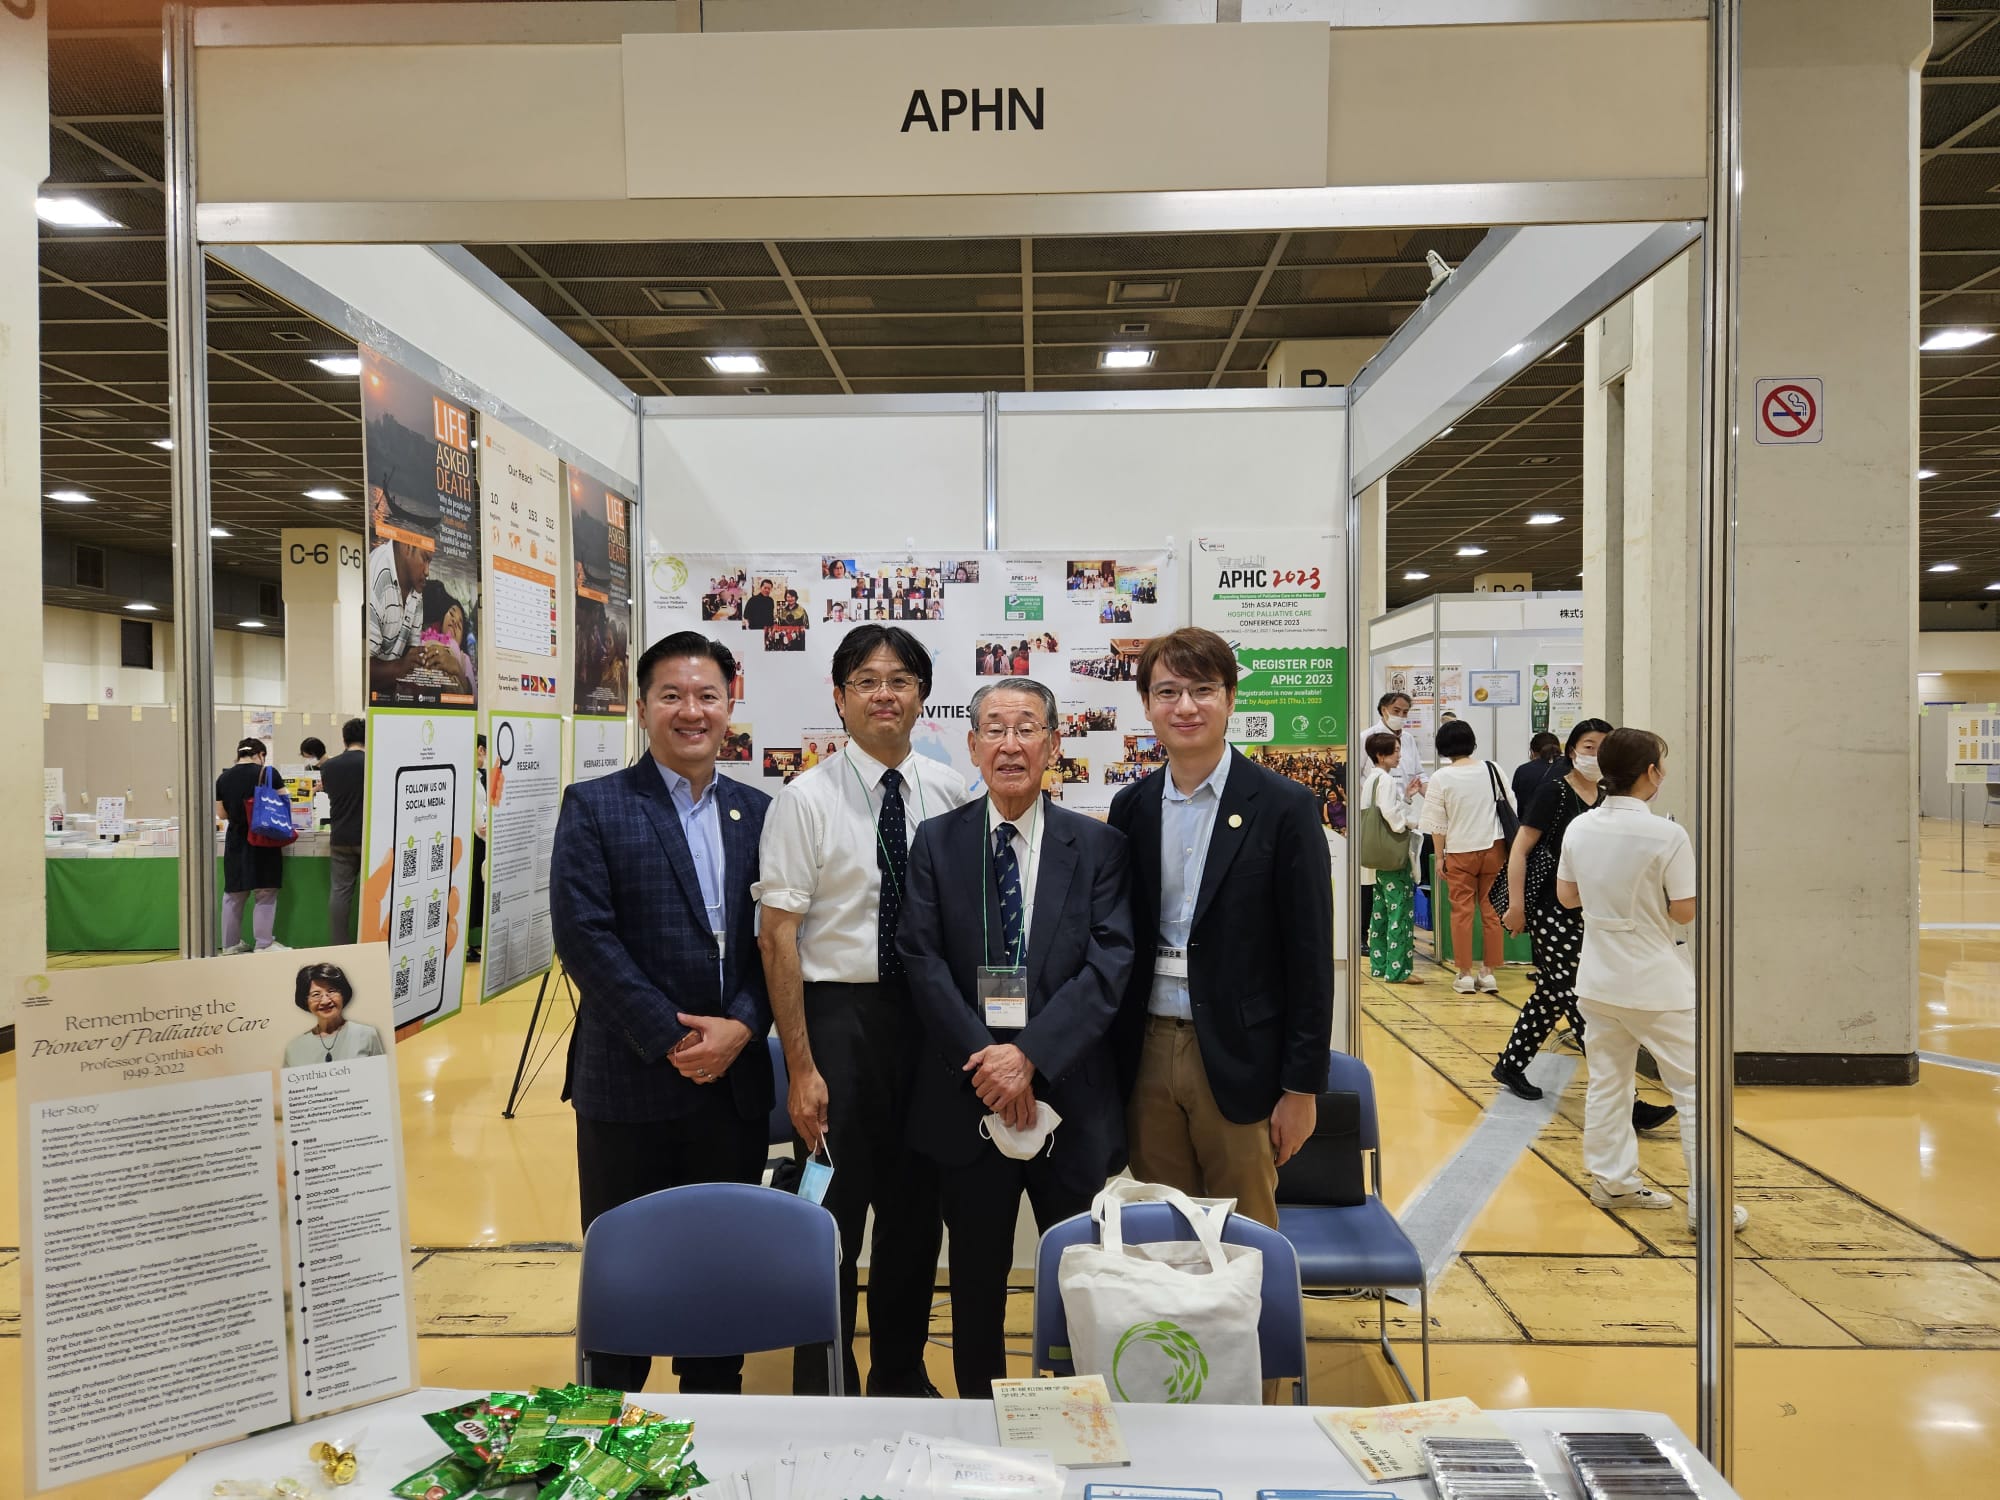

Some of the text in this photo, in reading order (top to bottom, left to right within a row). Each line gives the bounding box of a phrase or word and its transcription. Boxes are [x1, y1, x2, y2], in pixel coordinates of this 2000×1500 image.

[900, 88, 1044, 132] APHN
[434, 400, 467, 450] LIFE
[437, 443, 469, 478] ASKED
[508, 464, 533, 484] Our Reach
[437, 466, 471, 502] DEATH
[490, 492, 498, 504] 10
[511, 502, 518, 514] 48
[528, 509, 537, 522] 153
[606, 494, 624, 530] LIFE
[609, 526, 625, 548] ASKED
[290, 544, 328, 564] C-6
[340, 546, 360, 568] C-6
[609, 542, 627, 566] DEATH
[1218, 568, 1320, 590] APHC 2023
[1252, 659, 1332, 669] REGISTER FOR
[1270, 674, 1332, 684] APHC 2023
[1414, 676, 1434, 685] 玄米
[517, 761, 540, 771] RESEARCH
[406, 782, 446, 794] FOLLOW US ON
[406, 796, 446, 810] SOCIAL MEDIA:
[66, 1000, 237, 1032] Remembering the
[32, 1016, 270, 1057] Pioneer of Palliative Care
[80, 1044, 224, 1072] Professor Cynthia Goh
[123, 1062, 185, 1081] 1949-2022
[288, 1066, 351, 1084] Cynthia Goh
[308, 1096, 338, 1105] Consultant
[41, 1102, 100, 1119] Her Story
[307, 1110, 332, 1118] Advisory
[333, 1106, 363, 1114] Committee
[463, 1422, 487, 1440] MILO
